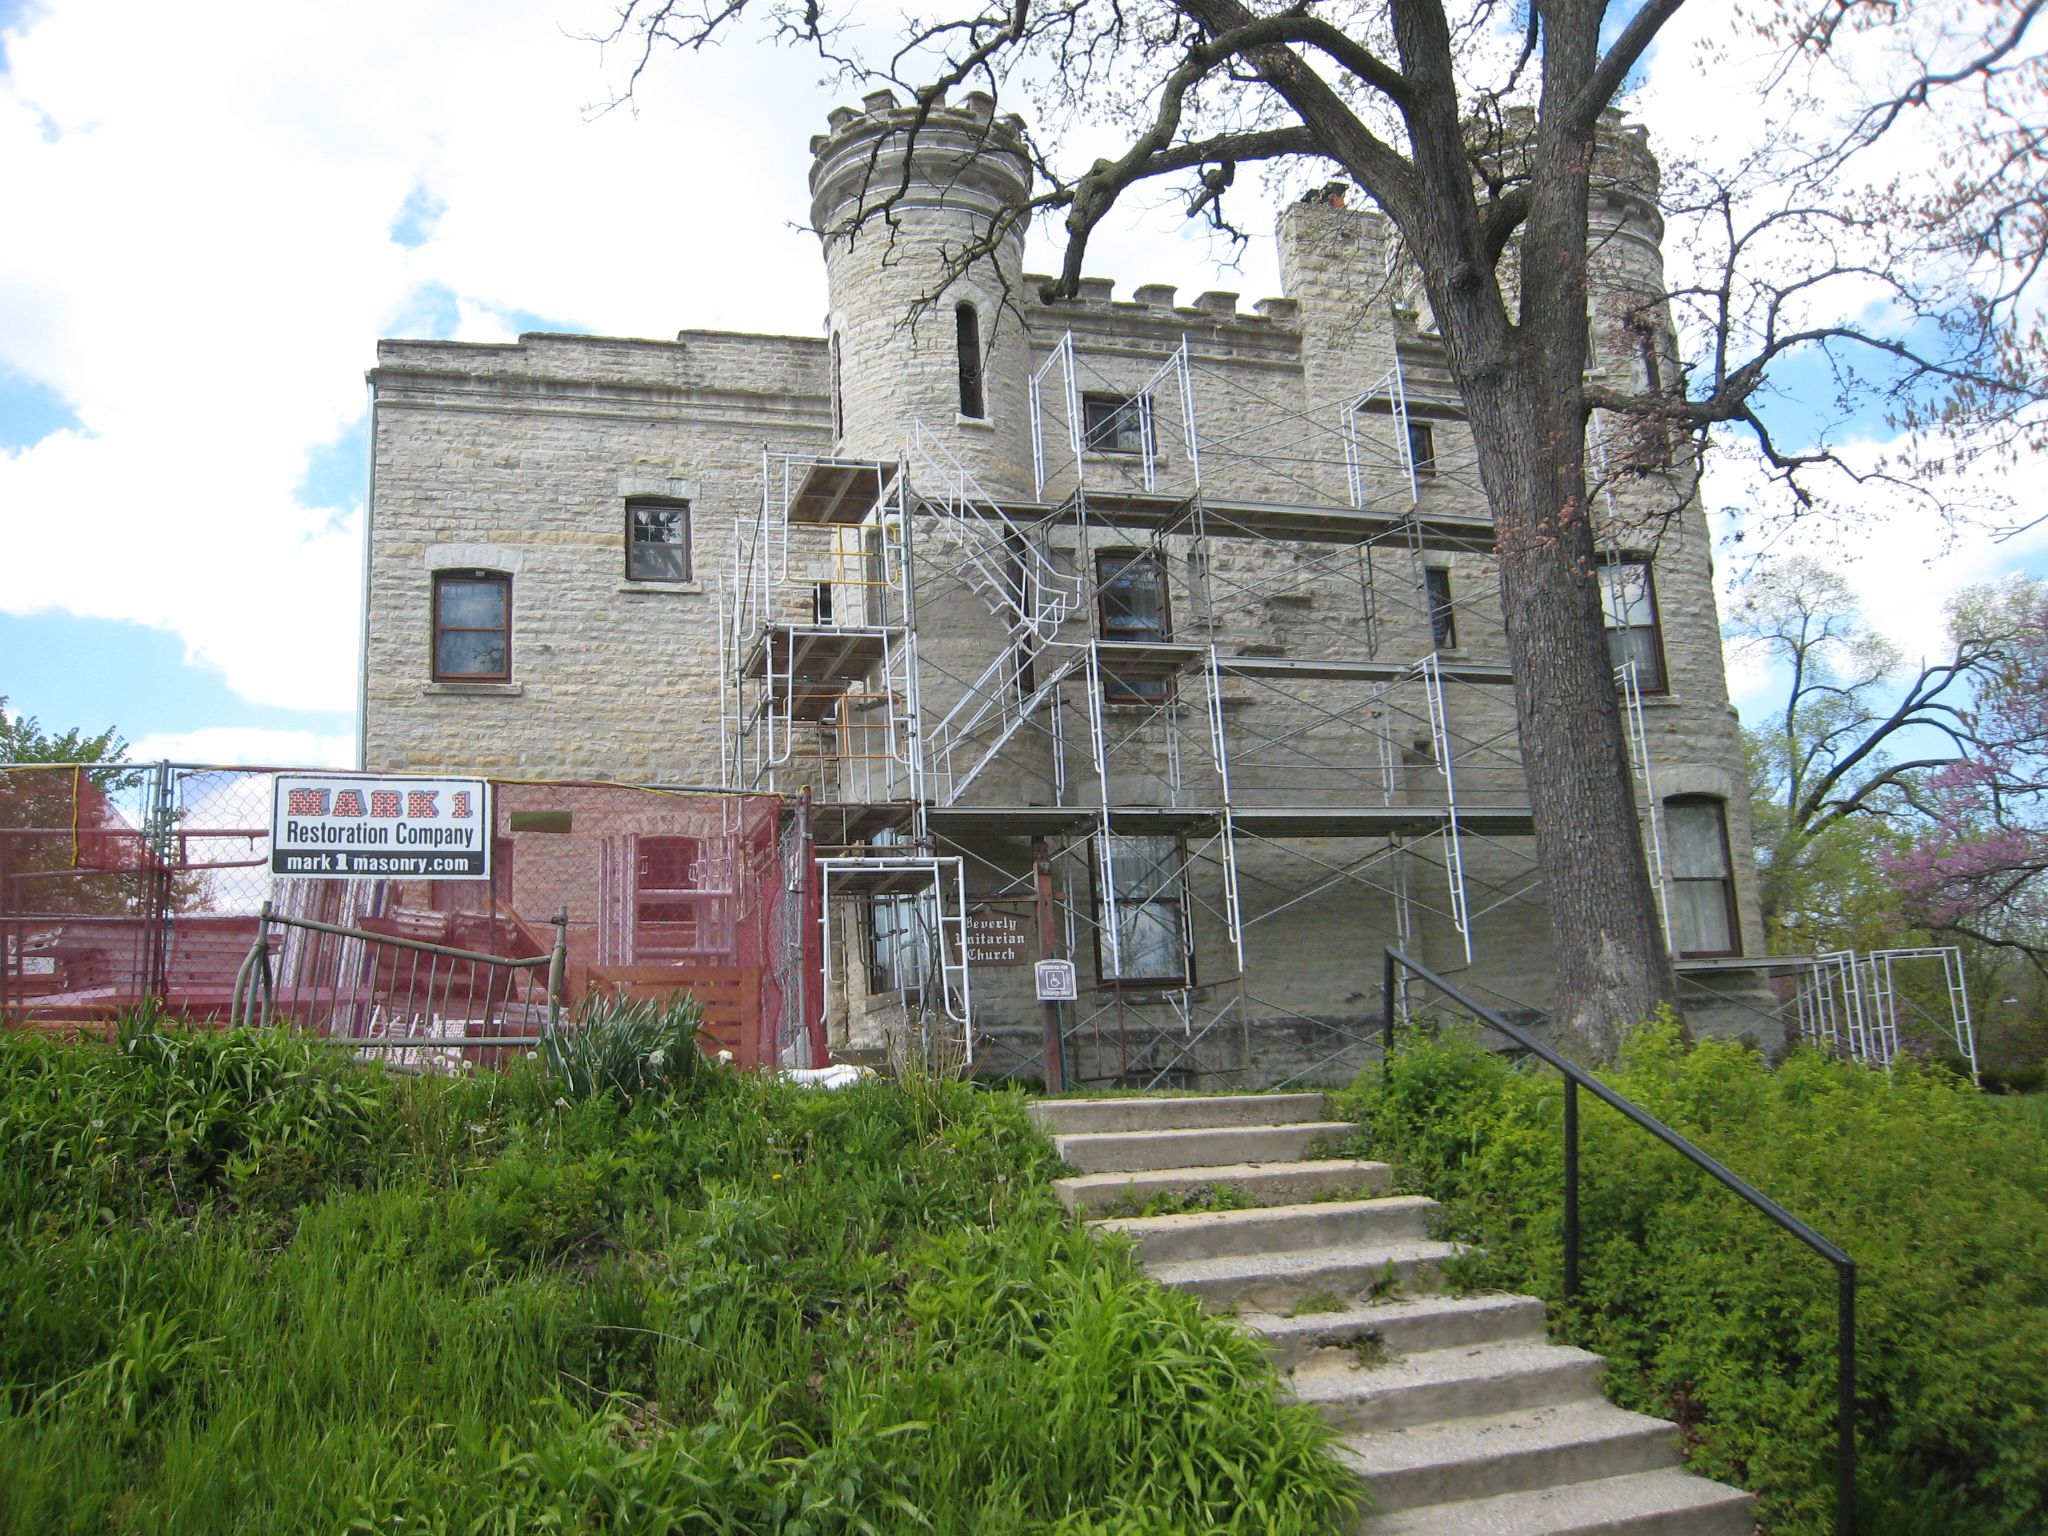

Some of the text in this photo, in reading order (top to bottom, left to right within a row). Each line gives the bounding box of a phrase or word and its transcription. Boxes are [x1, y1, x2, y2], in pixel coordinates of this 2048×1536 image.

[288, 788, 473, 818] MARK 1
[287, 821, 473, 847] Restoration Company
[966, 916, 1016, 930] Beverly
[967, 947, 1015, 960] Church
